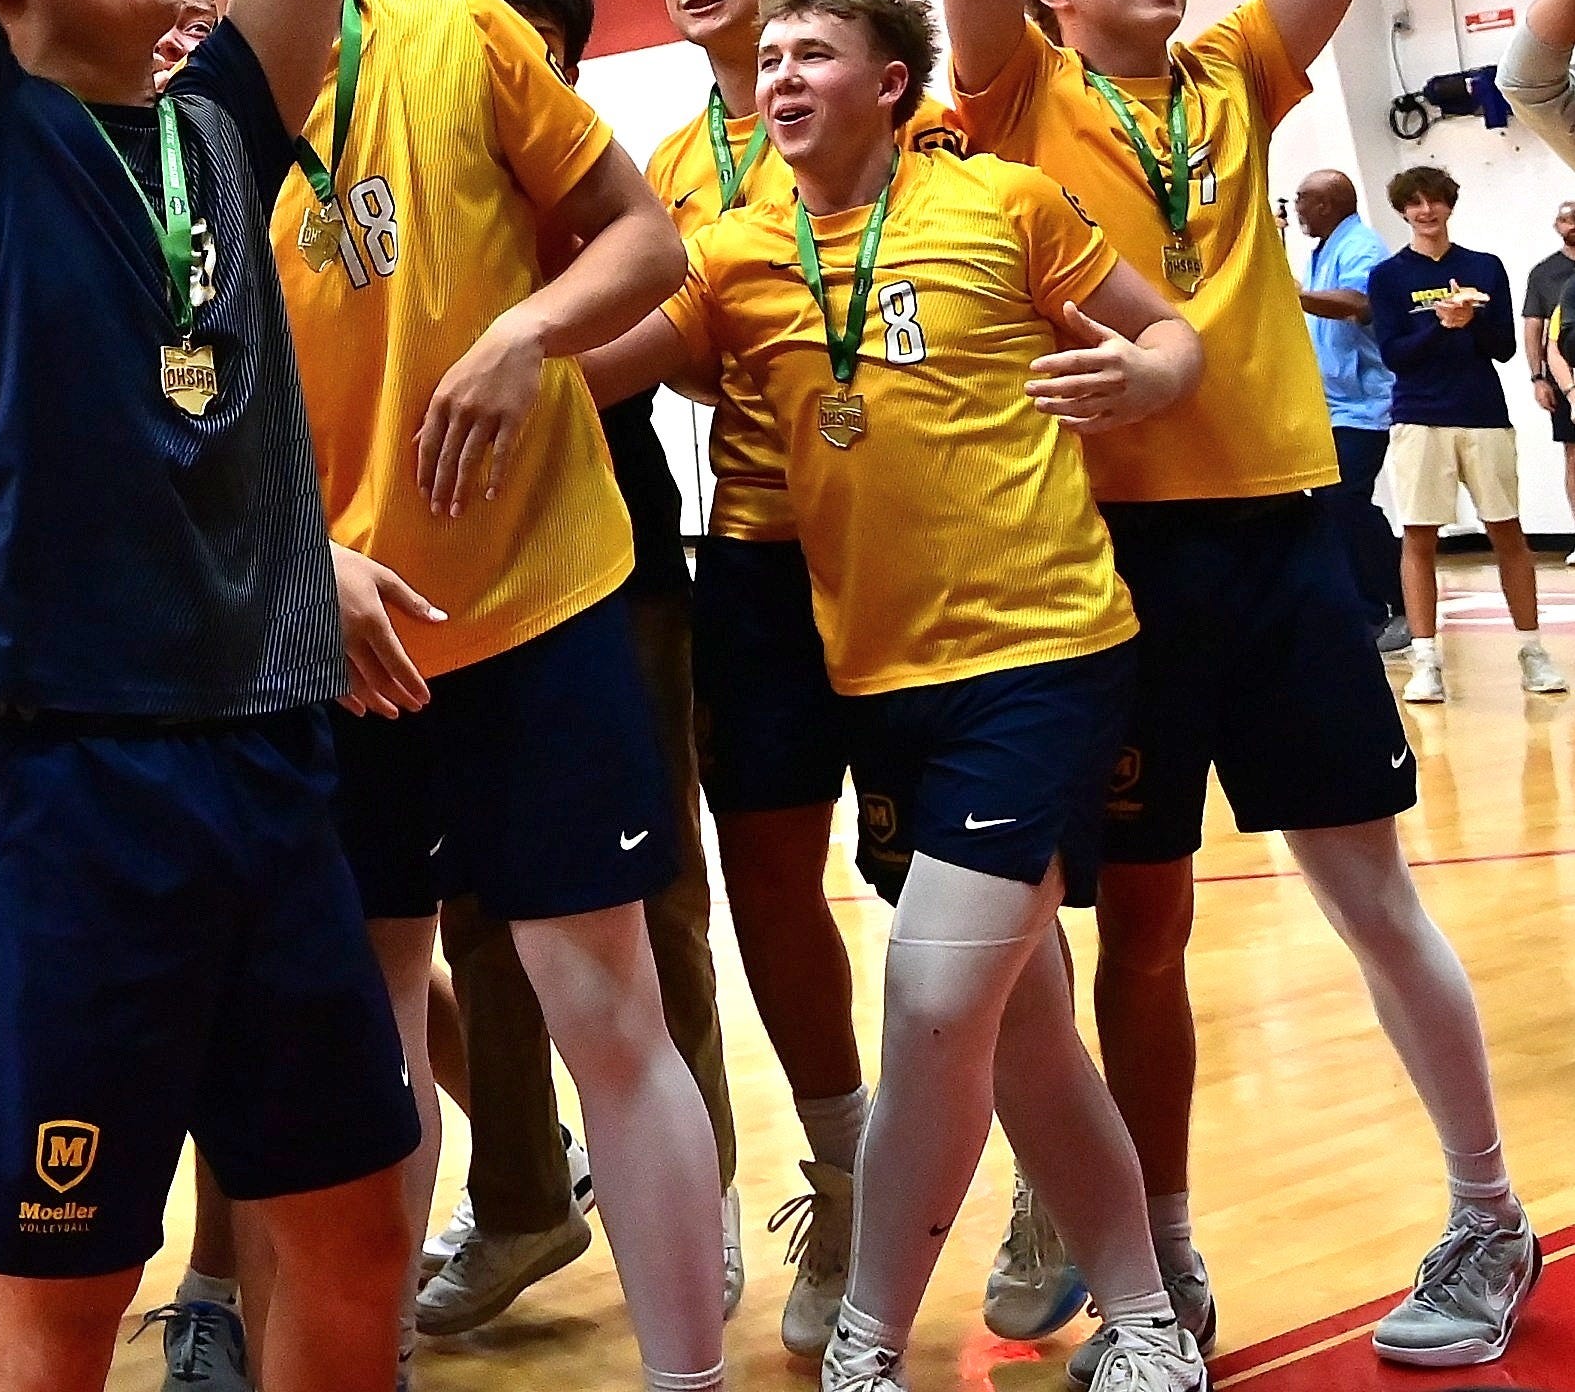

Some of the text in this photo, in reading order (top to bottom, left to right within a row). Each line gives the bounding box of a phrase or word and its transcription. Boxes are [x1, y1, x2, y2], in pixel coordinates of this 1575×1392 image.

[330, 175, 399, 291] 18
[877, 280, 928, 366] 8
[166, 367, 216, 394] OHSAA
[48, 1136, 88, 1167] M
[18, 1201, 98, 1221] Moeller
[19, 1223, 91, 1234] VOLLEYBALL
